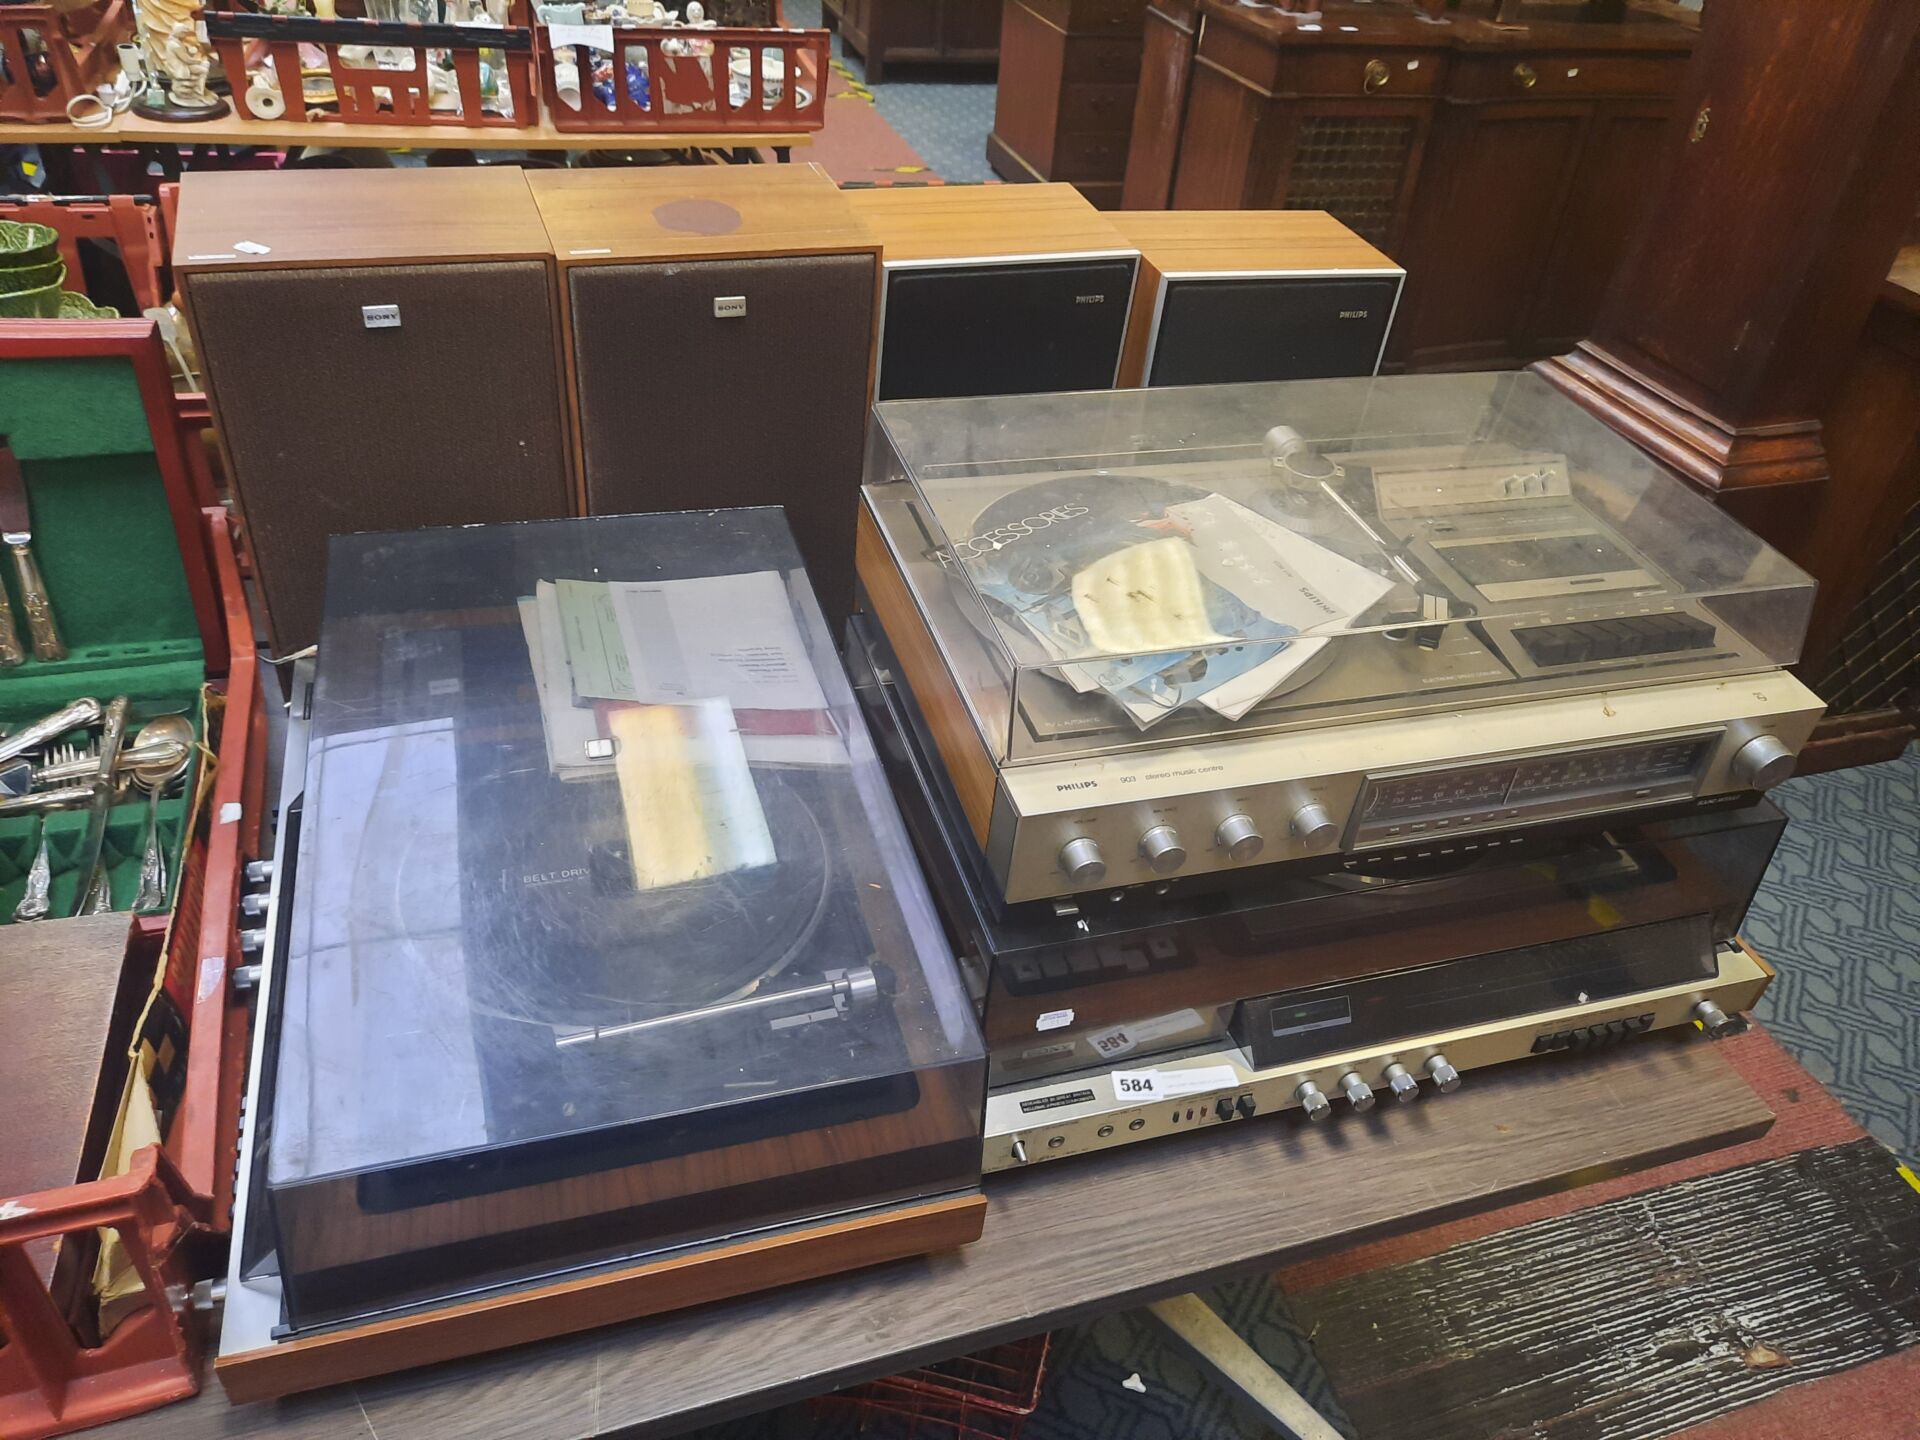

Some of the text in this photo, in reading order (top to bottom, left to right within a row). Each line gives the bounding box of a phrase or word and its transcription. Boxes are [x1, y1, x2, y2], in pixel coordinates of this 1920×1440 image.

[1075, 294, 1105, 304] PHILIPS
[717, 303, 745, 312] SONY
[366, 313, 398, 321] SONY
[1339, 310, 1368, 319] PHILIPS
[936, 502, 1089, 569] ACCESSORIES
[1299, 586, 1336, 615] PHILIPS
[1120, 765, 1224, 784] 903 stereo music centre
[1057, 780, 1098, 792] PHILIPS
[523, 867, 591, 883] BELT DRIV
[1120, 1078, 1154, 1092] 584
